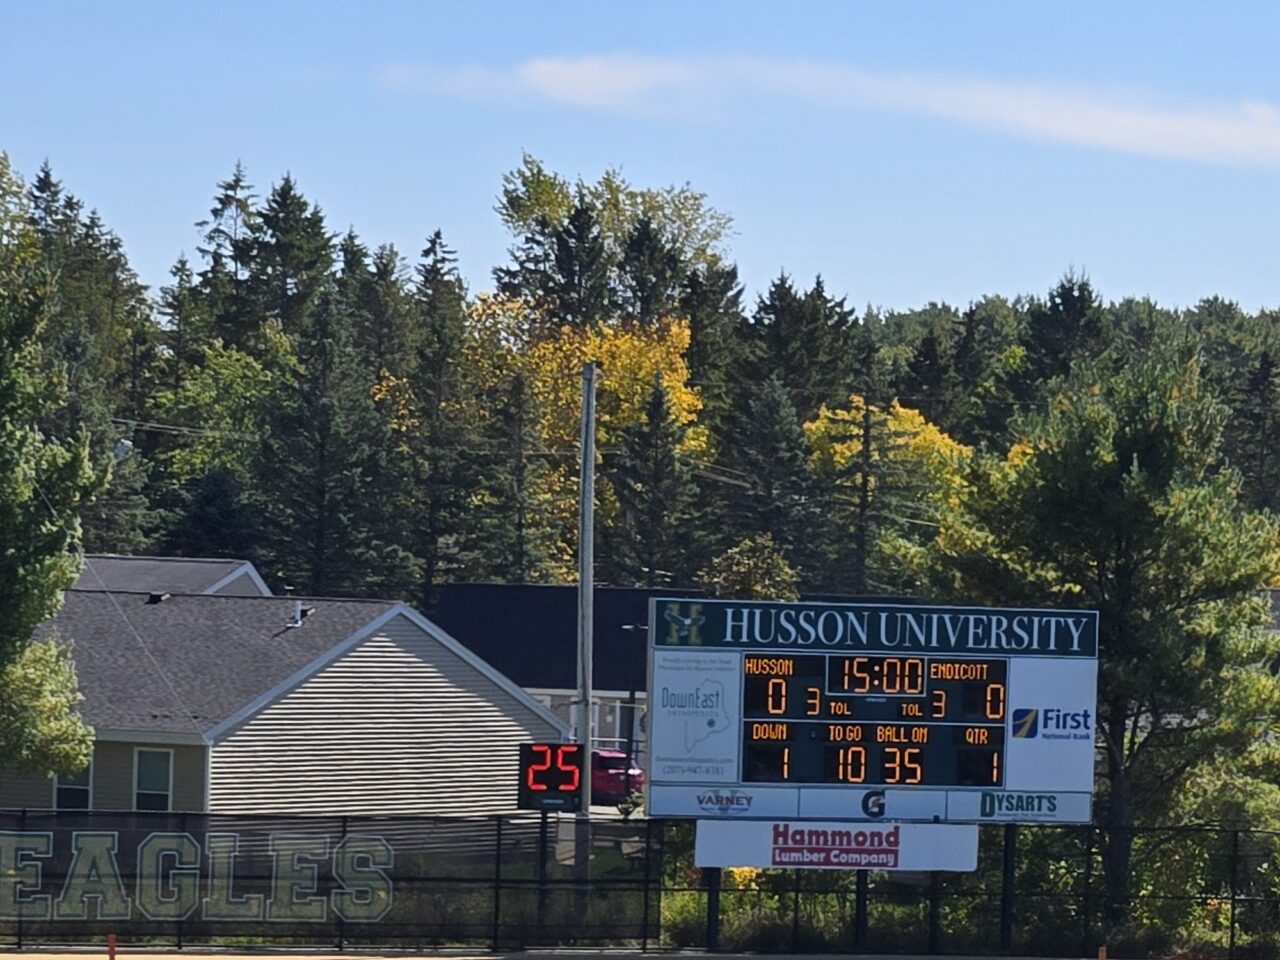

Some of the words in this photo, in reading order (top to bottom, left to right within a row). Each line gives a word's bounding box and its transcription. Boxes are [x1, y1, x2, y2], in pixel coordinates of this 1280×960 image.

[723, 608, 869, 646] HUSSON
[879, 612, 1088, 650] UNIVERSITY
[745, 658, 793, 675] HUSSON
[844, 657, 922, 693] 15:00
[930, 663, 989, 680] ENDICOTT
[662, 687, 719, 709] DownEast
[768, 678, 786, 714] 0
[807, 687, 820, 715] 3
[932, 690, 946, 717] 3
[986, 684, 1004, 719] 0
[830, 702, 852, 715] TOL
[901, 704, 923, 716] TOL
[1043, 708, 1091, 730] First
[753, 723, 787, 740] DOWN
[829, 726, 843, 741] TO
[846, 726, 862, 741] GO
[877, 726, 908, 742] BALL
[912, 727, 928, 743] ON
[966, 728, 988, 744] QTR
[527, 745, 580, 791] 25
[783, 748, 789, 779] 1
[839, 746, 866, 782] 10
[885, 748, 921, 783] 35
[993, 752, 999, 783] 1
[697, 795, 753, 807] VARNEY
[773, 824, 900, 847] Hammond
[775, 849, 826, 863] Lumber
[830, 851, 895, 866] Company
[0, 832, 394, 922] EAGLES
